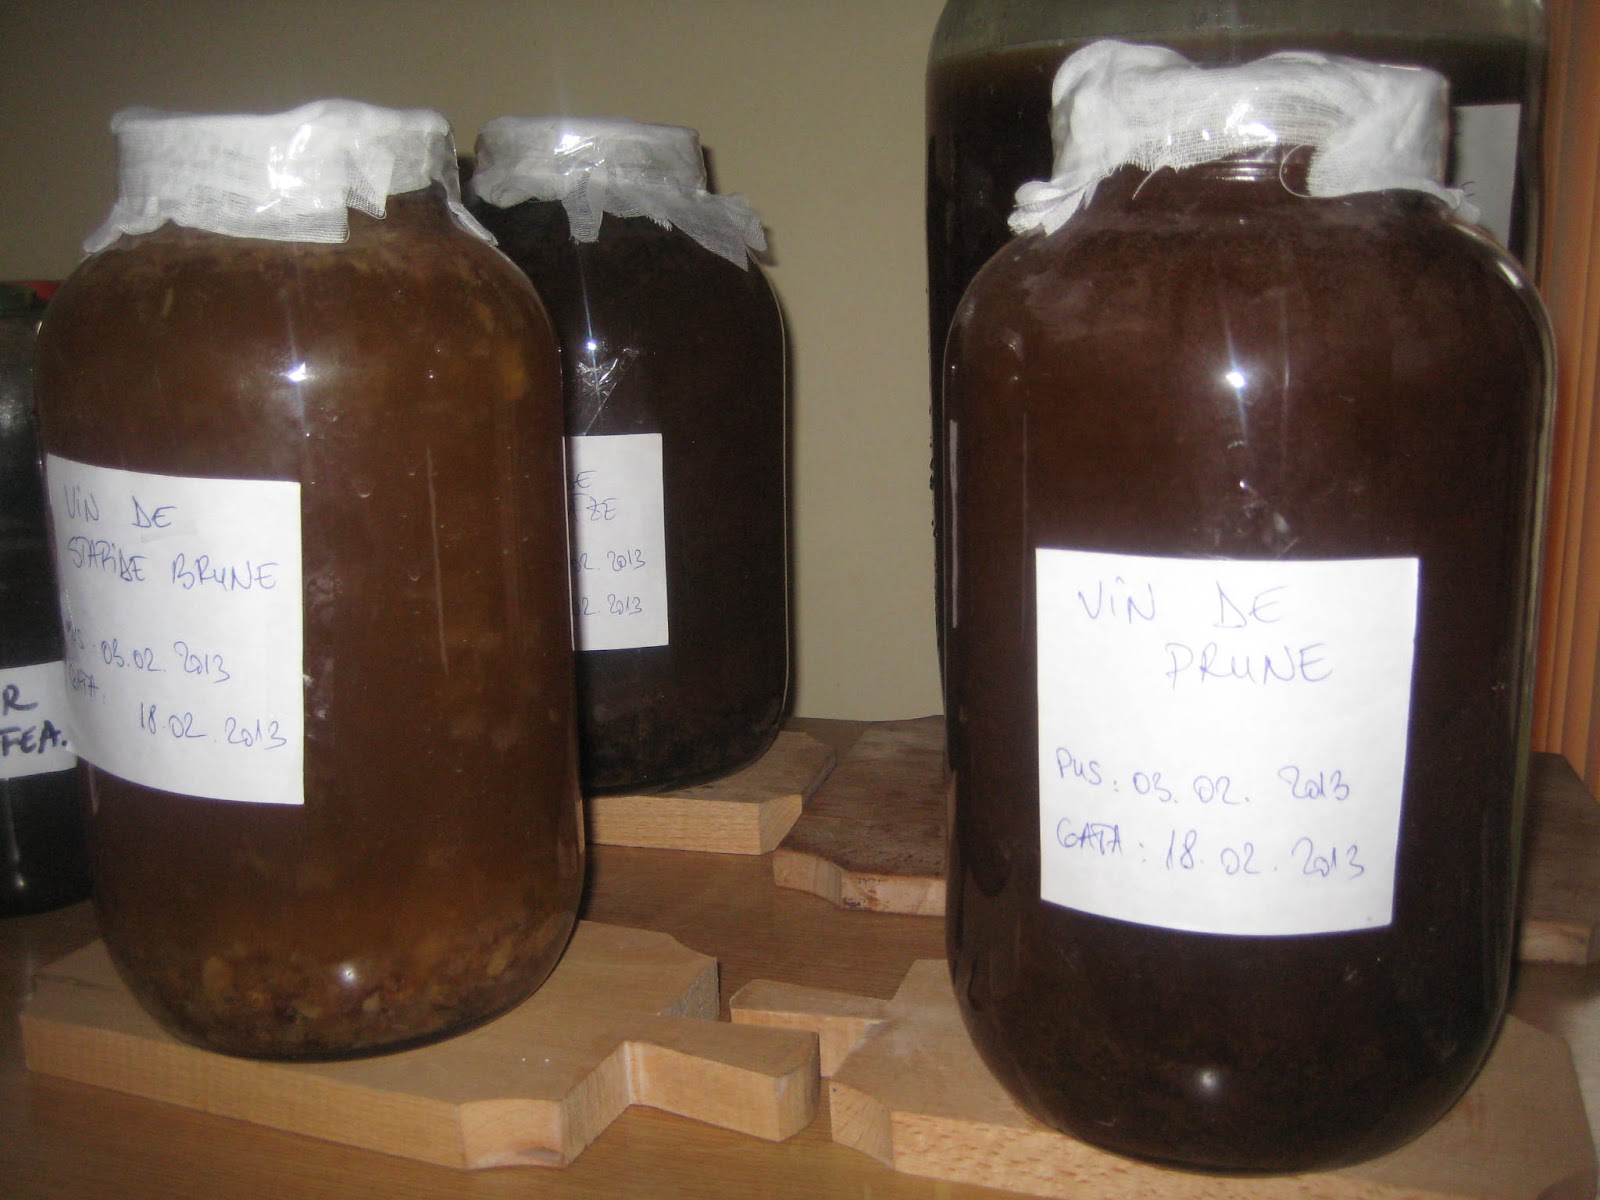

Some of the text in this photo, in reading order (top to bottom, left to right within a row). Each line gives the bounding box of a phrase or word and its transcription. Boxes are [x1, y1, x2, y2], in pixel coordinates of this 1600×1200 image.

[131, 495, 178, 529] DE
[606, 549, 646, 572] 2013
[606, 593, 643, 616] 2013
[1213, 581, 1289, 629] DE
[1165, 641, 1334, 689] PRUNE
